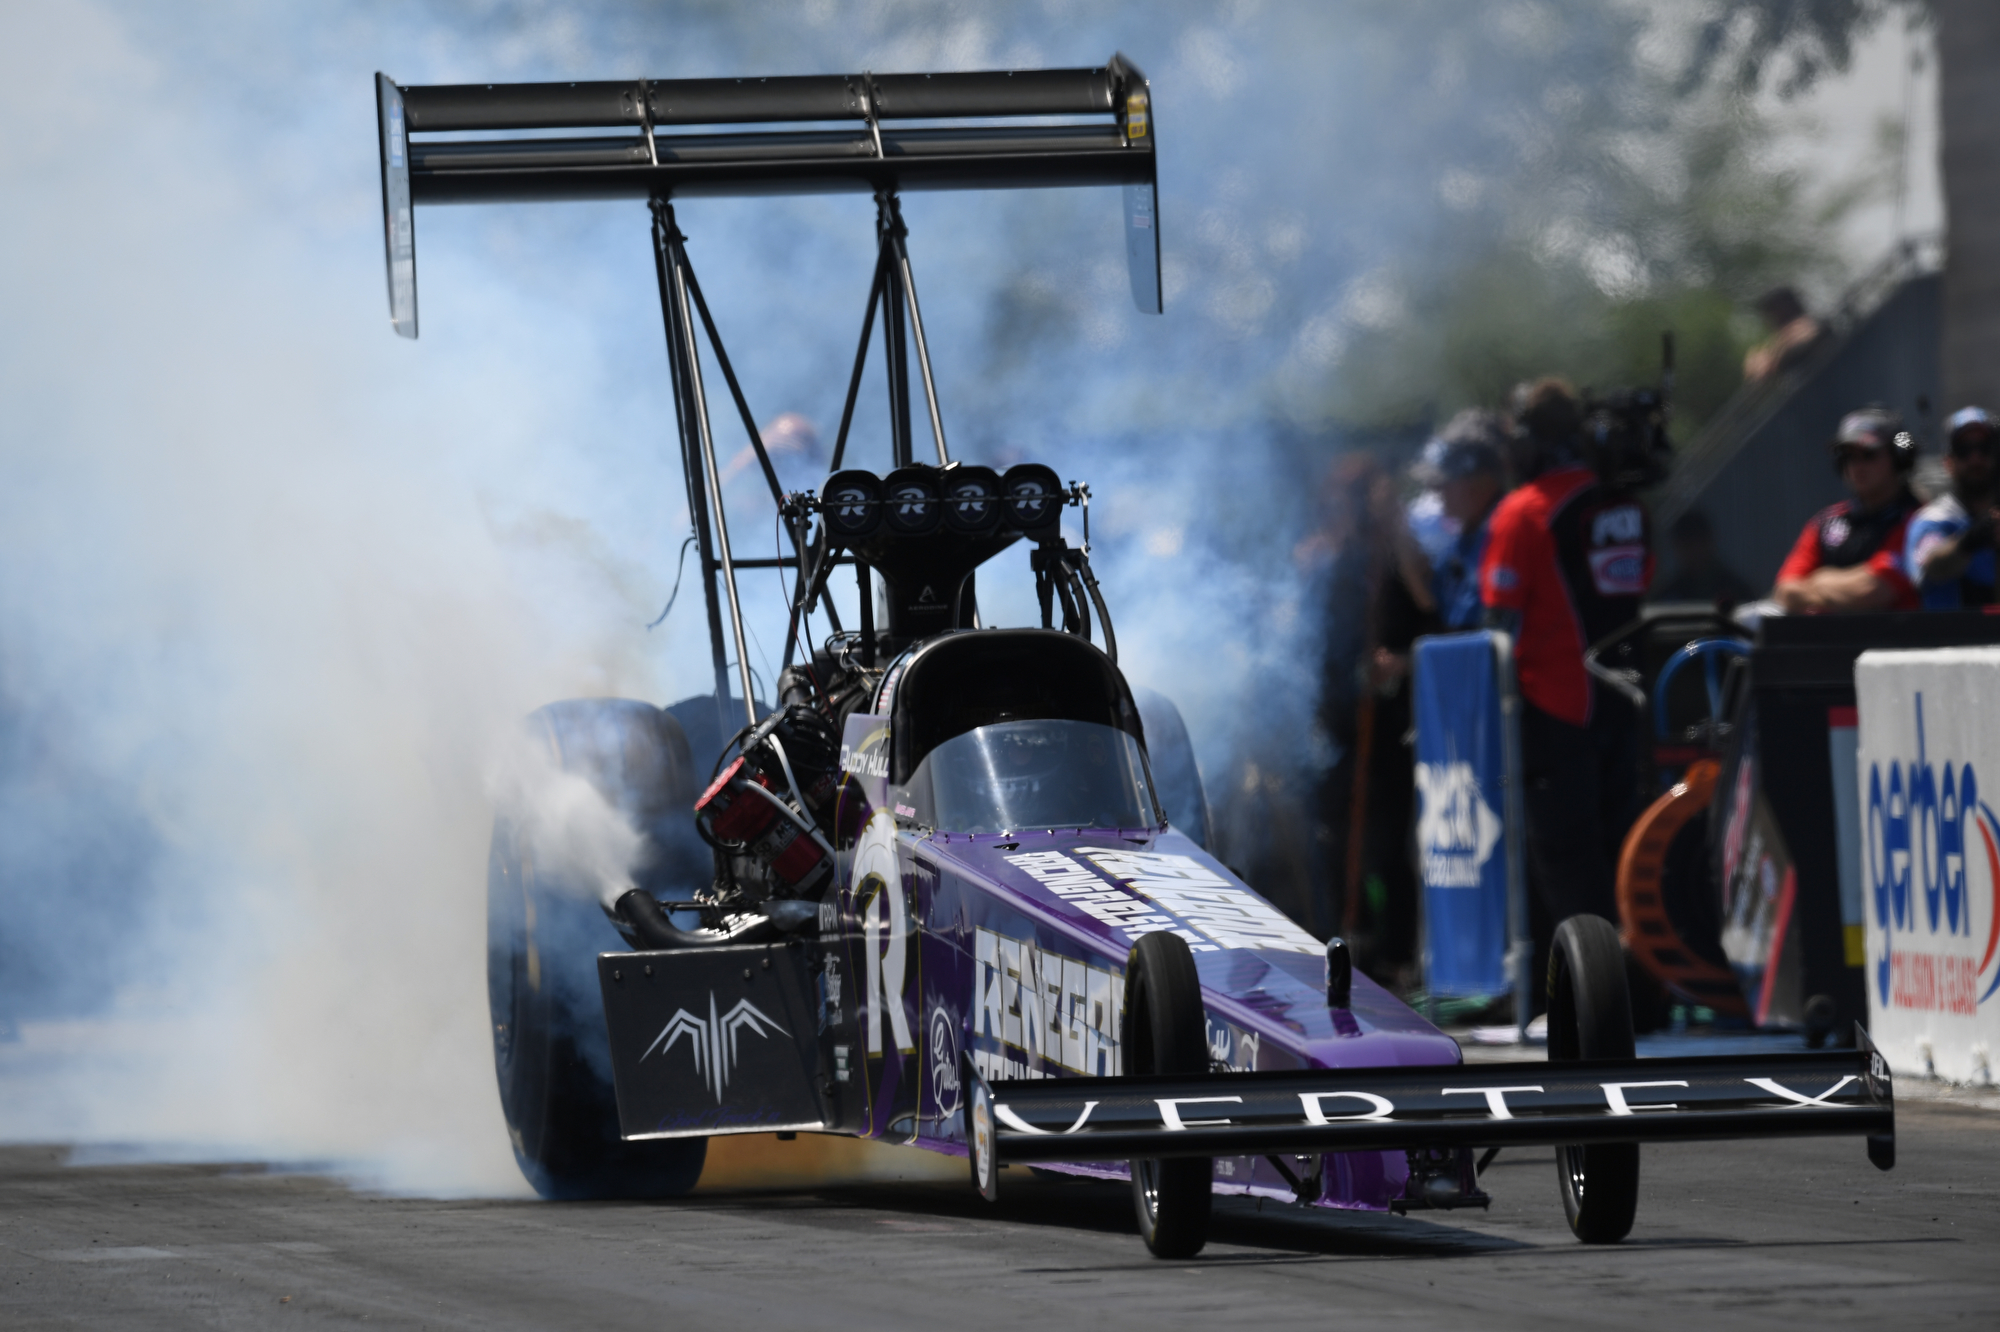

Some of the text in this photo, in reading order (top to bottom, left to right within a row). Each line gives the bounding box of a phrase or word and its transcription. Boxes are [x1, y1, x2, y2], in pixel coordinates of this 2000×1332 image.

[867, 748, 889, 778] HULL
[776, 820, 794, 838] MS
[1868, 692, 1978, 1008] gerber
[1003, 850, 1115, 895] RACING
[1058, 890, 1173, 927] FUELS
[1071, 846, 1328, 956] RENEGADE
[975, 925, 1126, 1078] RENEGA
[993, 1075, 1862, 1135] VERTEX
